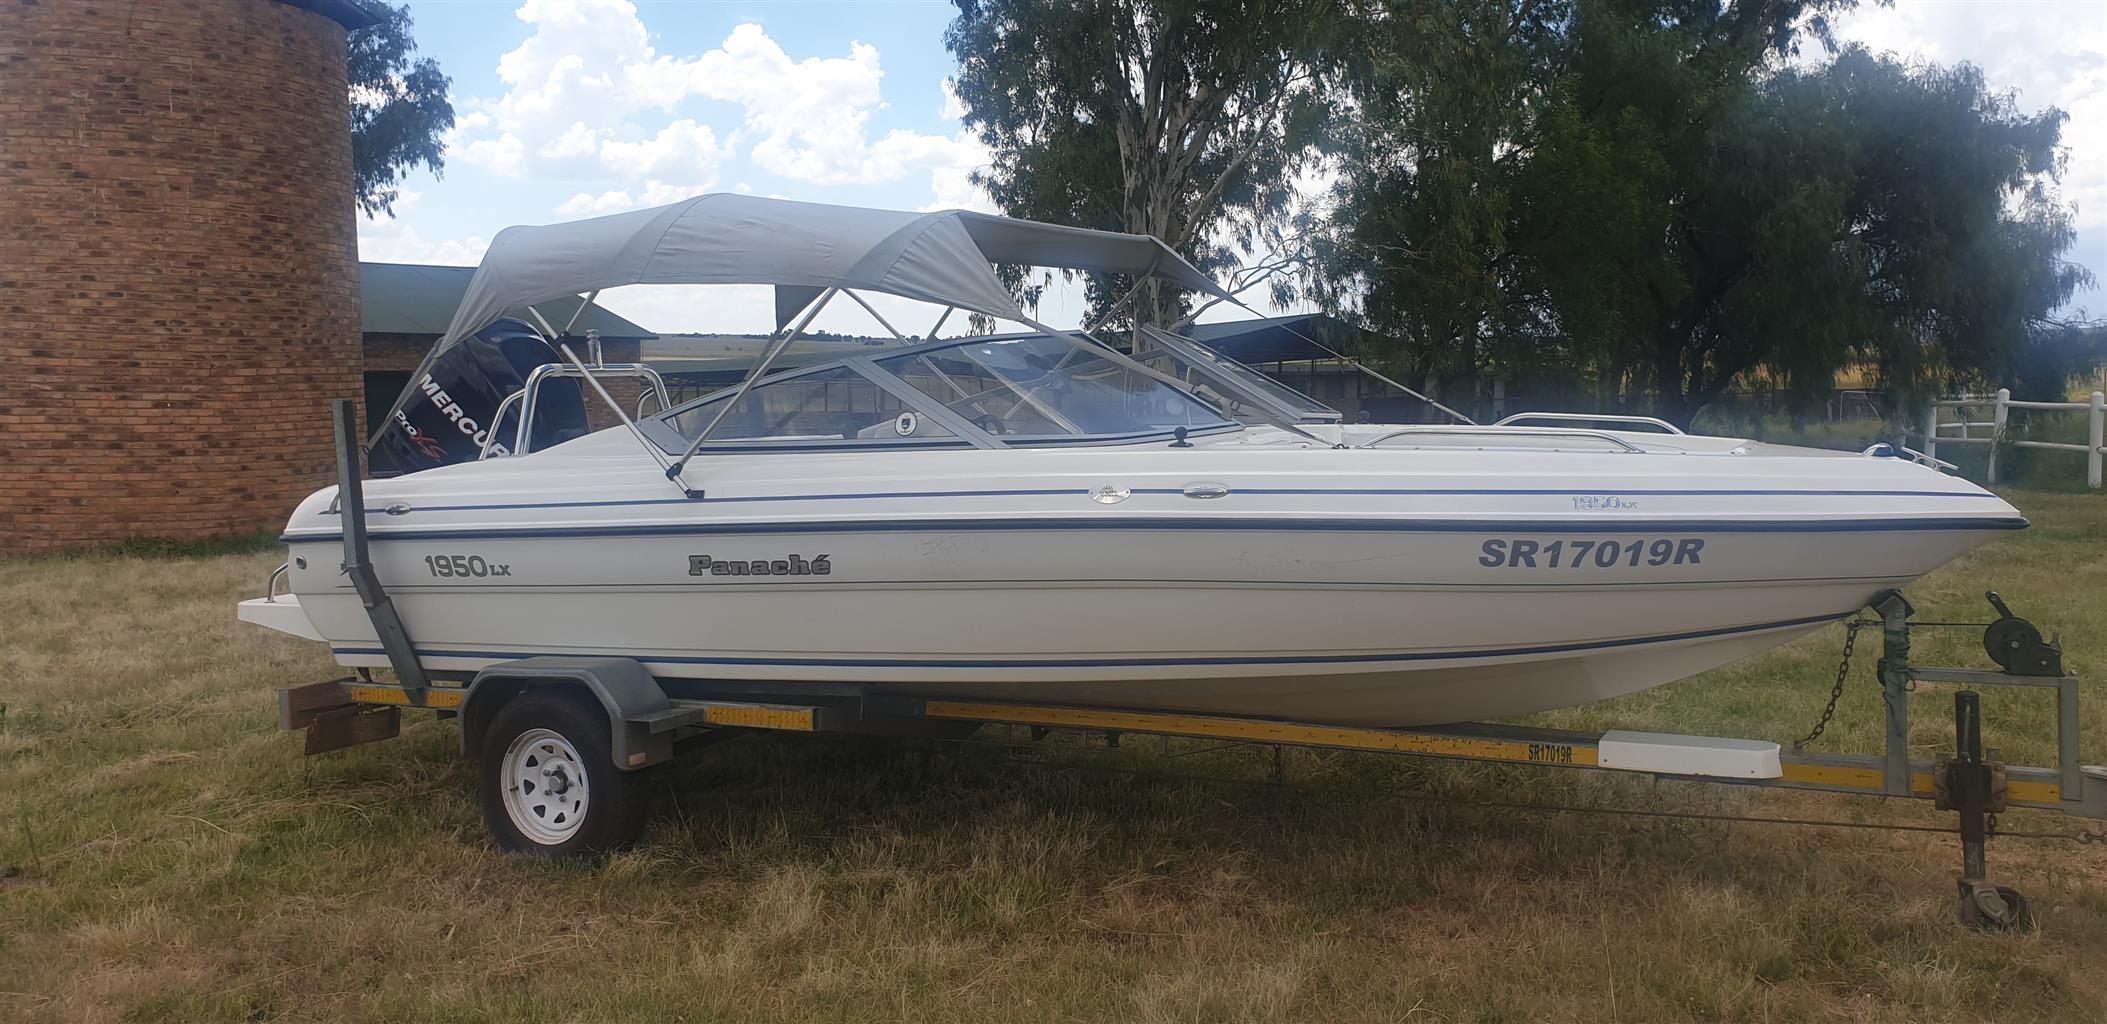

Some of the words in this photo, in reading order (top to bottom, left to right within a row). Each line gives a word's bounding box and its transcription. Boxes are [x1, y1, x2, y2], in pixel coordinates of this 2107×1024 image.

[1478, 537, 1705, 569] SR17019R
[424, 555, 488, 578] 1950
[488, 564, 512, 577] LX
[688, 553, 831, 577] Panaché
[1527, 743, 1573, 763] SR17019R
